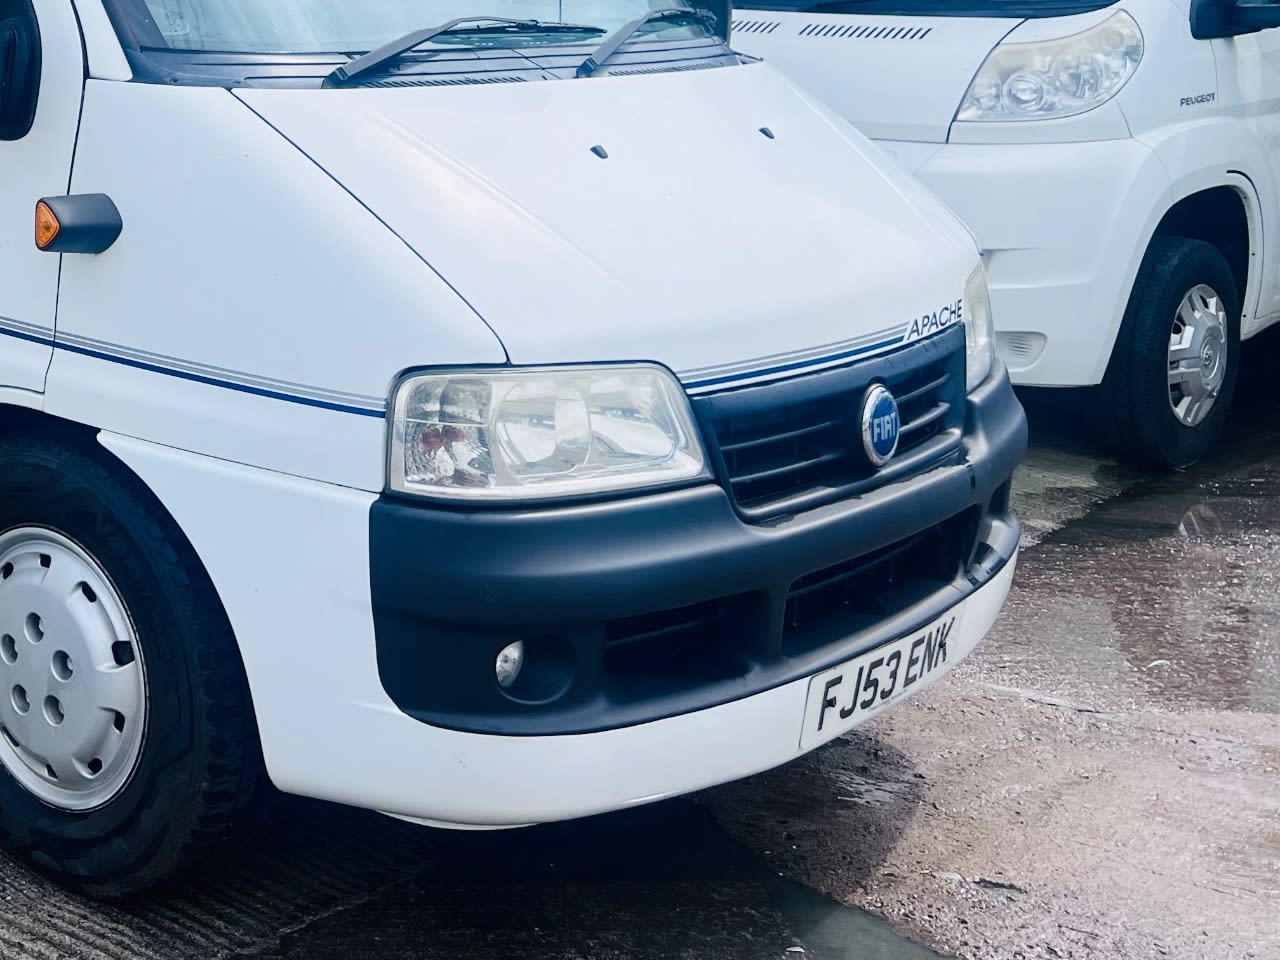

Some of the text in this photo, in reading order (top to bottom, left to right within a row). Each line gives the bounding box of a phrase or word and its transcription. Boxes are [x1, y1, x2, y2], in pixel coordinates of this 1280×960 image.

[1180, 92, 1216, 107] PEUGEOT
[906, 298, 963, 341] APACHE
[873, 411, 897, 443] FIAT
[816, 616, 956, 732] FJ53 ENK
